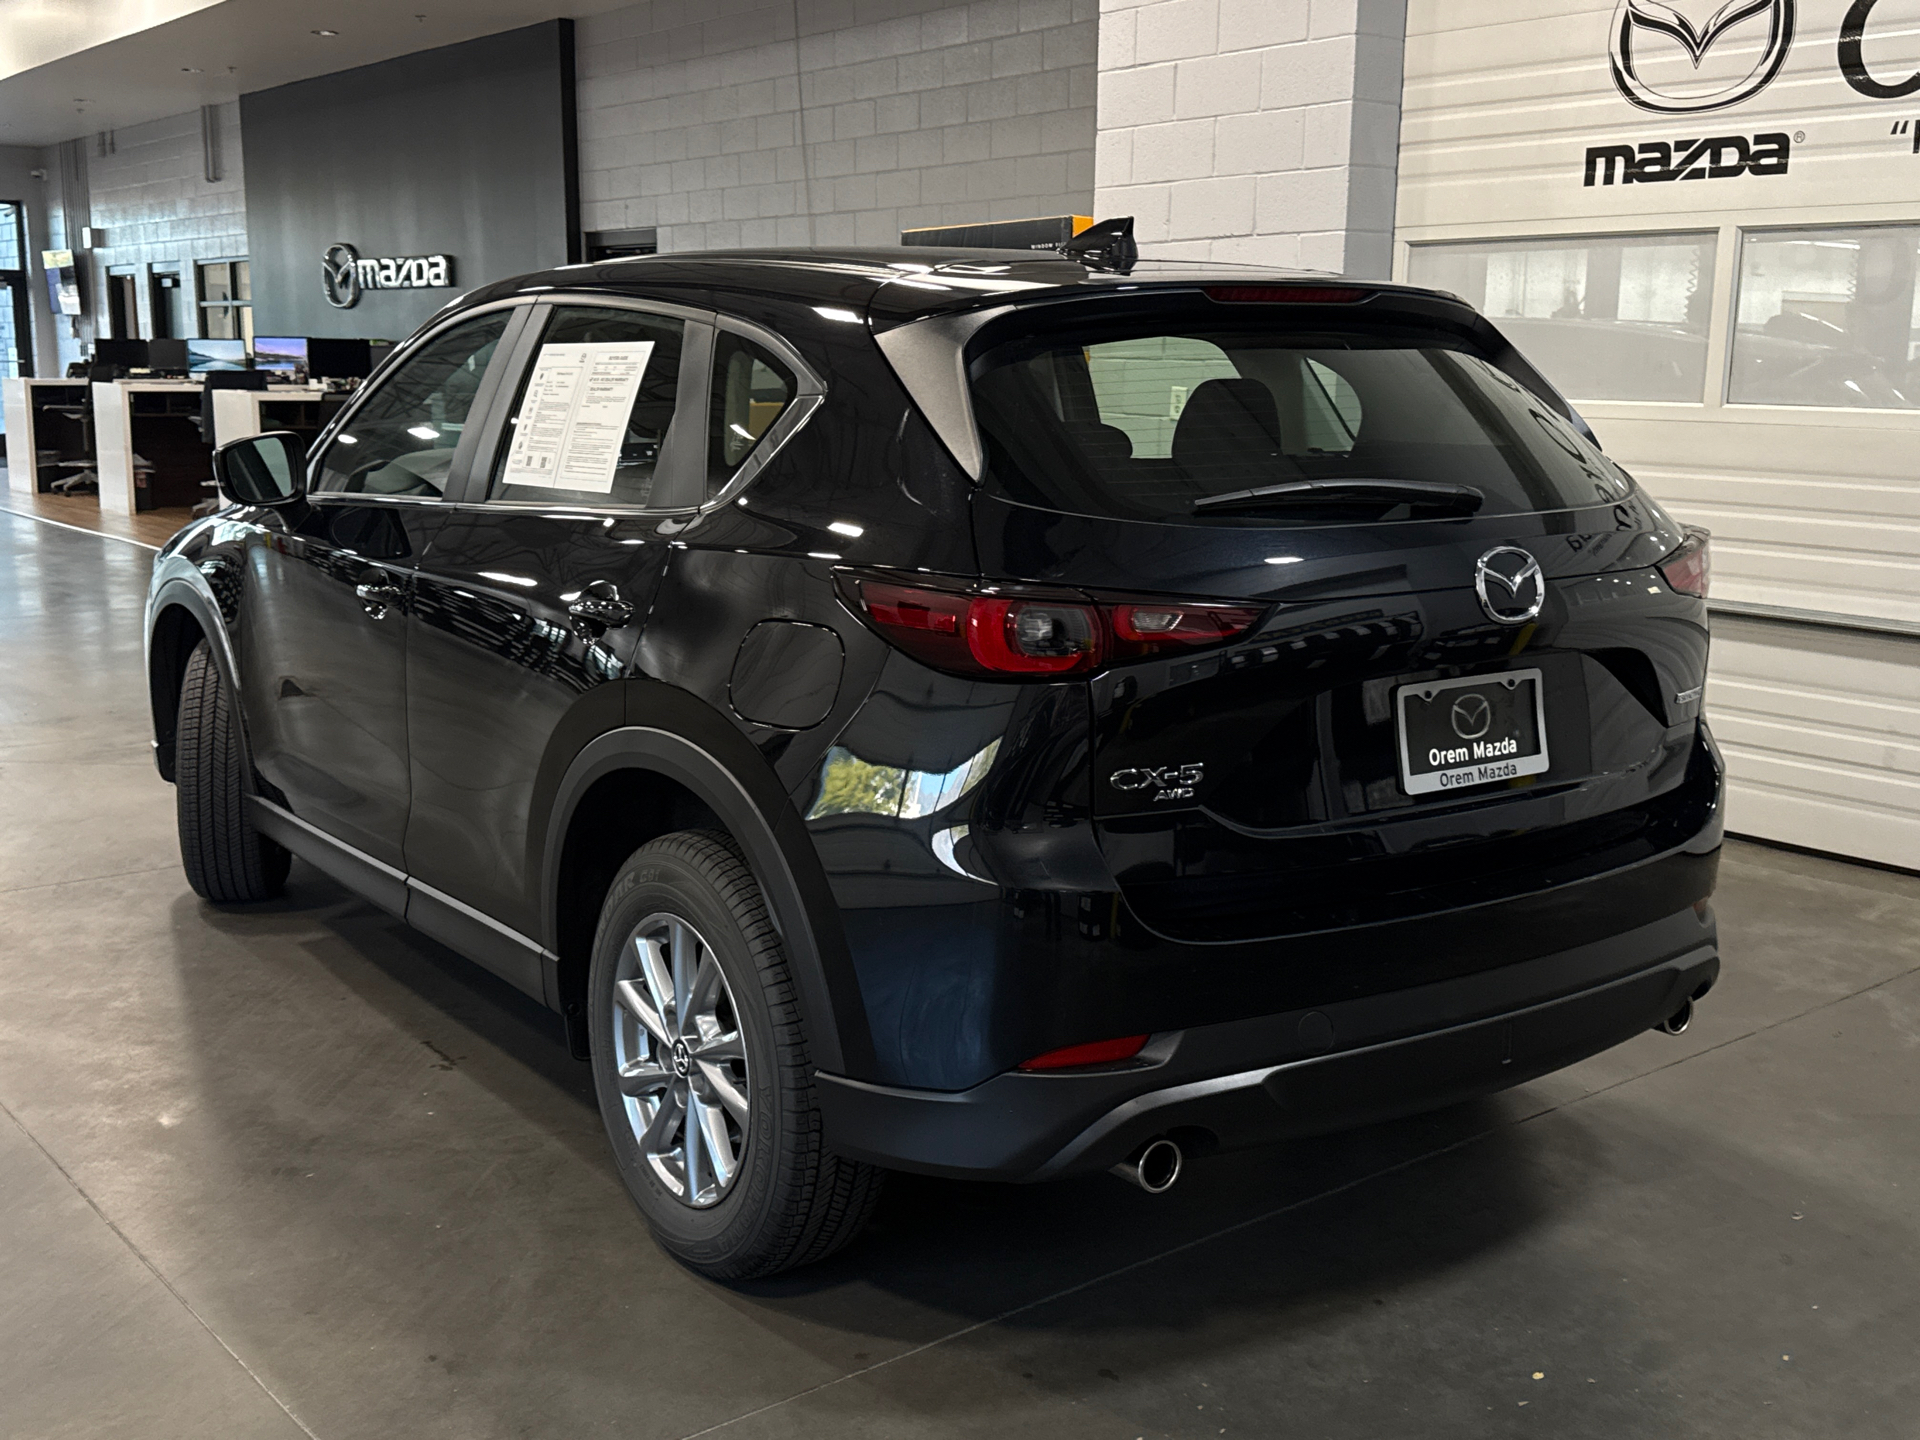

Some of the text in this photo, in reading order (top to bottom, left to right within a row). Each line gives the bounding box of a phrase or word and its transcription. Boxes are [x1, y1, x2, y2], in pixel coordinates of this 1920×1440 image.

[1428, 736, 1517, 766] Orem Mazda
[1110, 762, 1204, 790] CX-5
[1440, 762, 1517, 787] Orem Mazda
[1153, 787, 1195, 802] AWD
